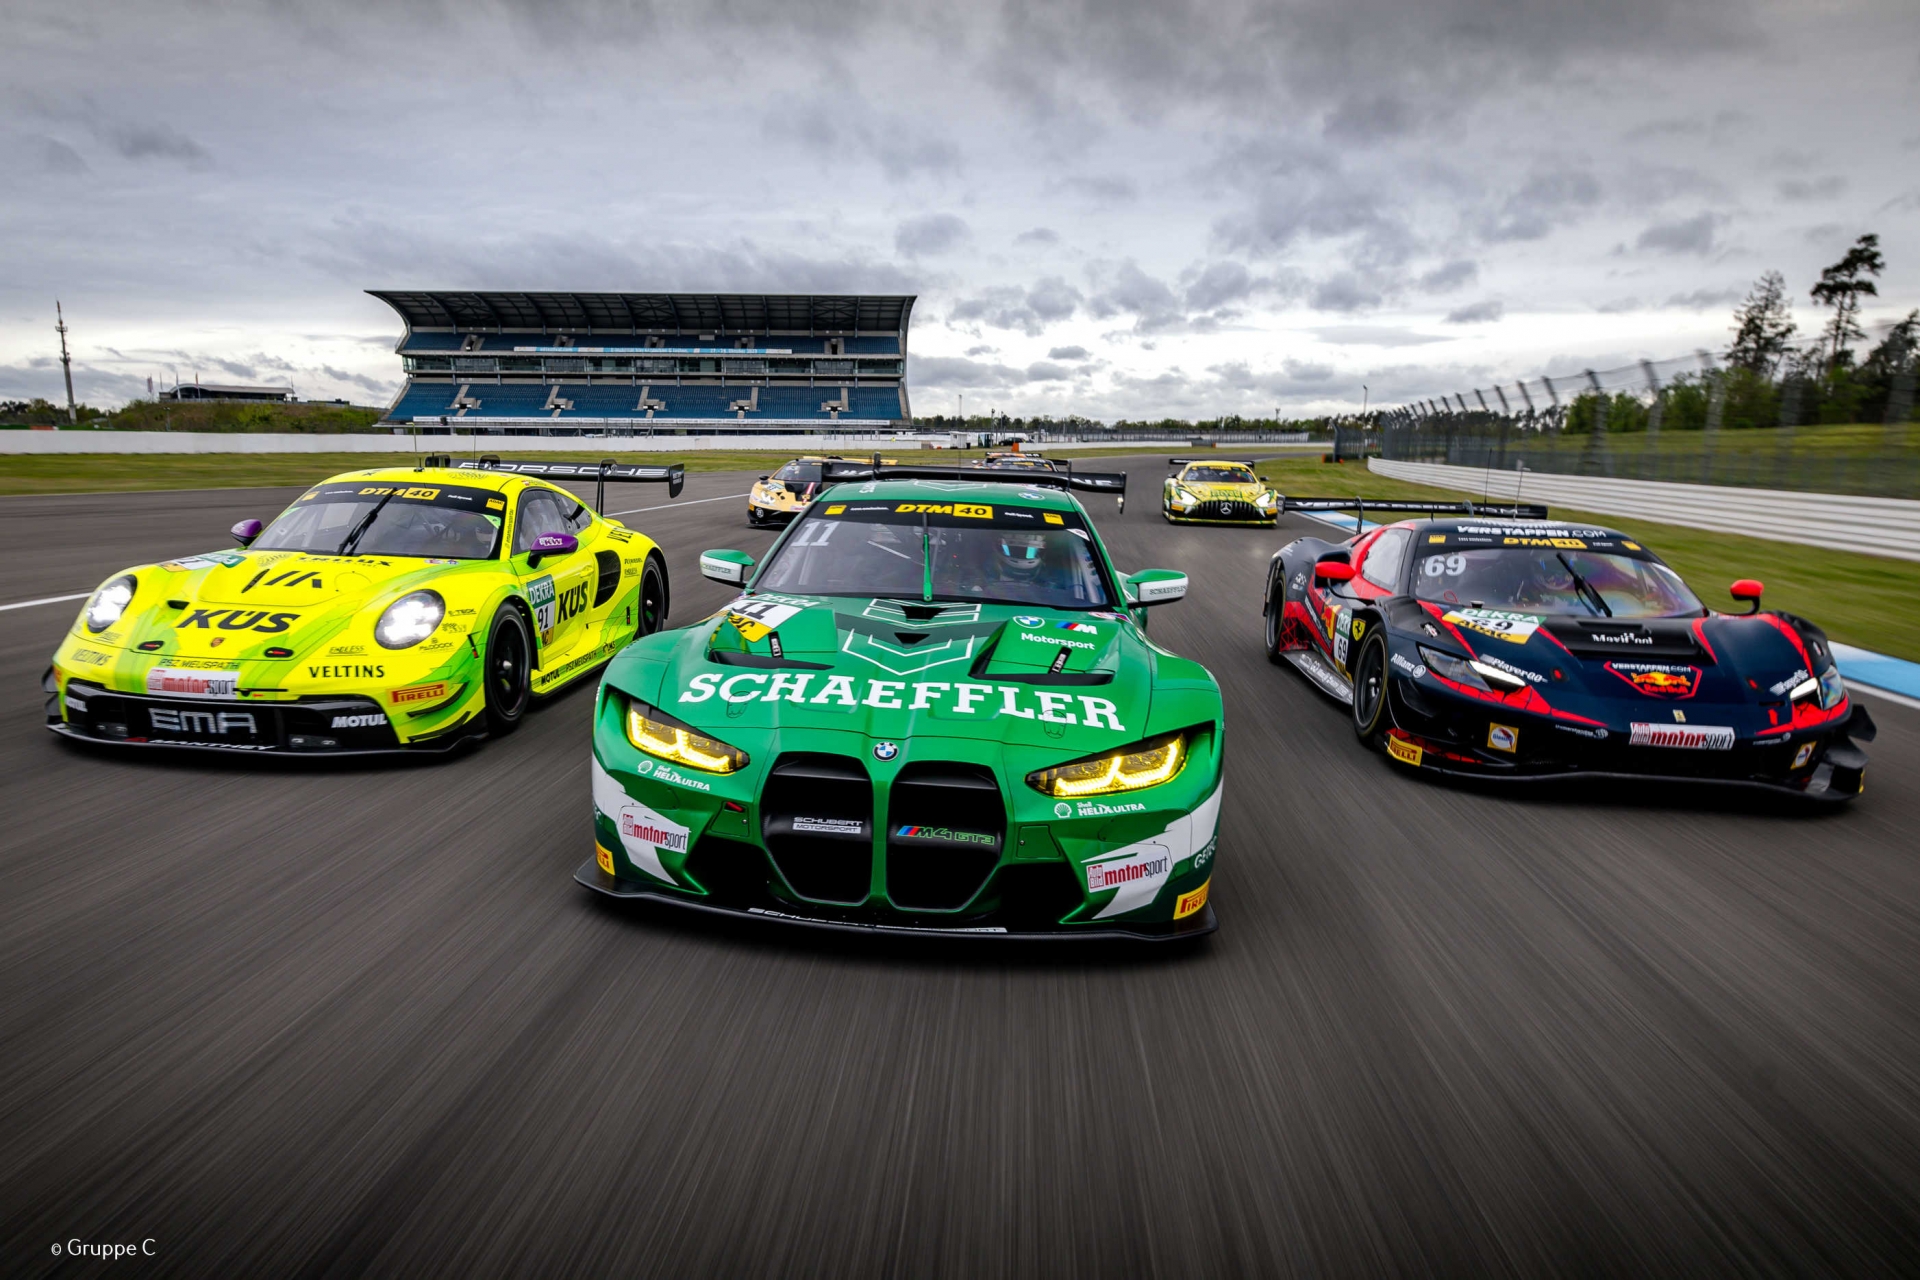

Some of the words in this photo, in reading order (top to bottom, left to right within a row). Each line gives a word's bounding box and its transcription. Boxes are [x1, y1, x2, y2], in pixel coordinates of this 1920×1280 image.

[894, 504, 954, 514] DTM
[958, 506, 988, 516] 40
[790, 521, 840, 547] 11
[1502, 537, 1551, 546] DTM
[1423, 554, 1467, 577] 69
[528, 581, 555, 604] DEKRA
[557, 580, 589, 625] KÜS
[731, 602, 779, 621] 11
[176, 609, 301, 633] KÜS
[1460, 608, 1540, 625] DEKRA
[1021, 632, 1096, 650] Motorsport
[1338, 638, 1348, 662] 69
[309, 665, 385, 678] VELTINS
[1390, 652, 1416, 673] Allianz
[541, 669, 560, 685] MOTUL
[392, 683, 444, 703] PIRELLI
[1643, 683, 1666, 692] Red
[1667, 685, 1688, 694] Bull
[678, 673, 1126, 732] SCHAEFFLER
[331, 714, 388, 728] MOTUL
[1650, 730, 1733, 751] motorsport
[653, 769, 683, 784] HELIX
[681, 778, 711, 791] ULTRA
[1078, 803, 1113, 816] HELIX
[1112, 803, 1147, 813] ULTRA
[794, 816, 863, 827] SCHUBERT
[795, 823, 859, 832] MOTORSPORT
[634, 824, 687, 851] motorsport
[954, 831, 996, 846] GT3
[1104, 855, 1168, 886] motorsport
